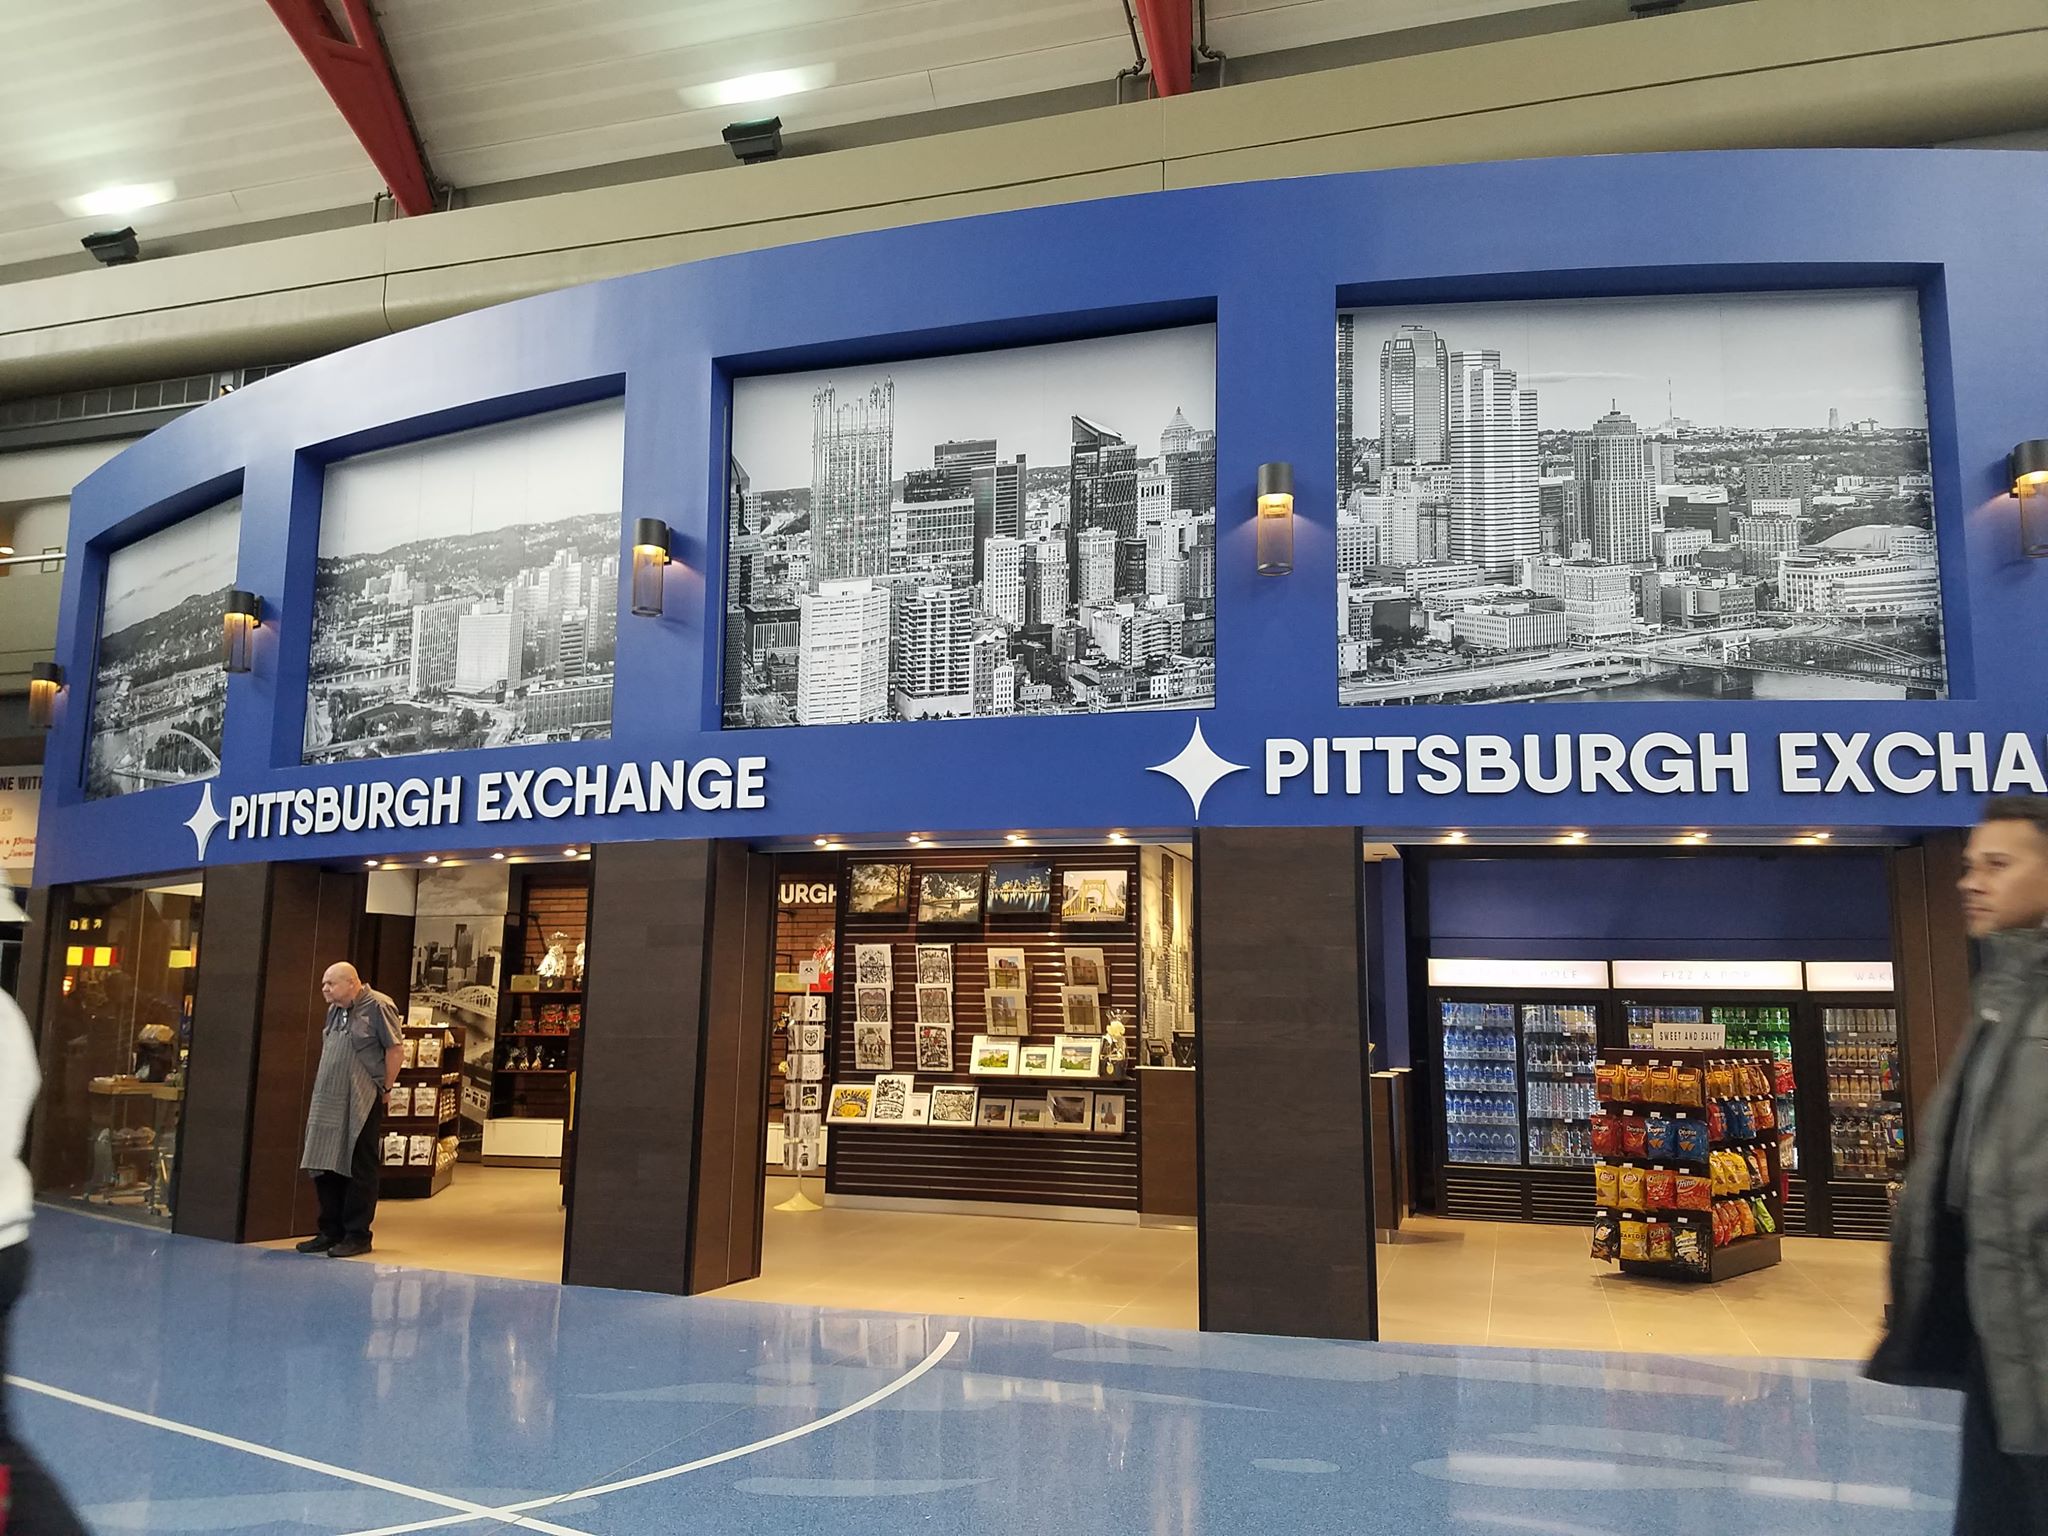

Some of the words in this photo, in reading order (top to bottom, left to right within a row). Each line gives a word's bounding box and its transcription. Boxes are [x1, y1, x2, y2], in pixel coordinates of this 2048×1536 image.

[1265, 731, 1750, 795] PITTSBURGH
[1779, 731, 2048, 794] EXCHA
[228, 775, 462, 840] PITTSBURGH
[477, 756, 766, 822] EXCHANGE
[778, 883, 837, 904] URGH
[1660, 1031, 1681, 1041] SWEET
[1684, 1031, 1698, 1041] AND
[1701, 1031, 1720, 1041] SALTY
